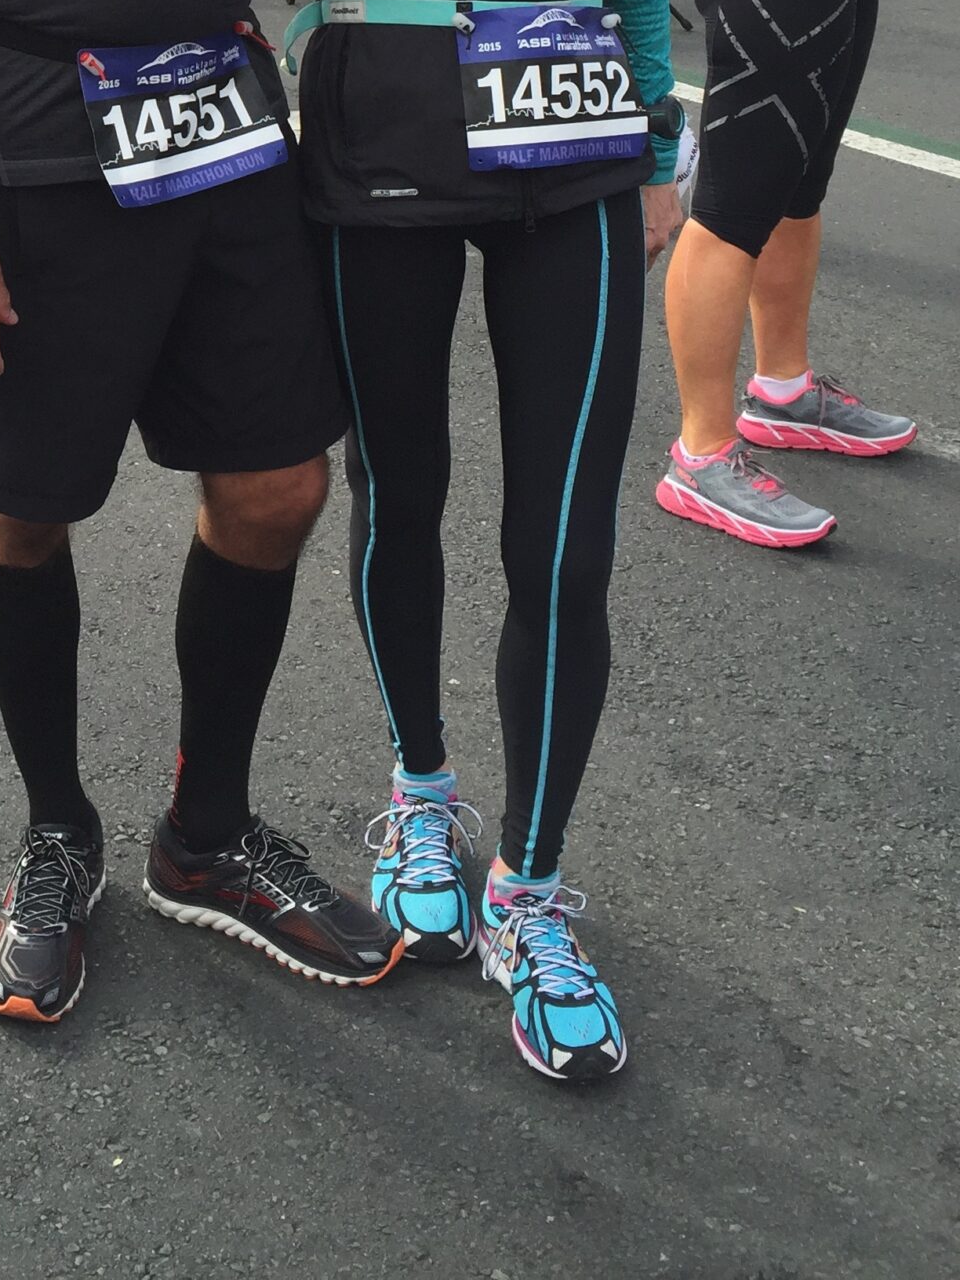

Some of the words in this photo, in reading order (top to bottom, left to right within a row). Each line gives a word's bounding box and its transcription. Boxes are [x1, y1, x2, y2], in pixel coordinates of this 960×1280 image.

[478, 42, 501, 52] 2015
[517, 37, 551, 49] ASB
[98, 79, 120, 90] 2015
[137, 73, 172, 85] ASB
[477, 61, 636, 123] 14552
[102, 77, 253, 160] 14551
[497, 149, 534, 165] HALF
[540, 141, 604, 161] MARATHON
[609, 140, 632, 154] RUN
[129, 184, 162, 202] HALF
[165, 163, 234, 194] MARATHON
[239, 152, 265, 172] RUN
